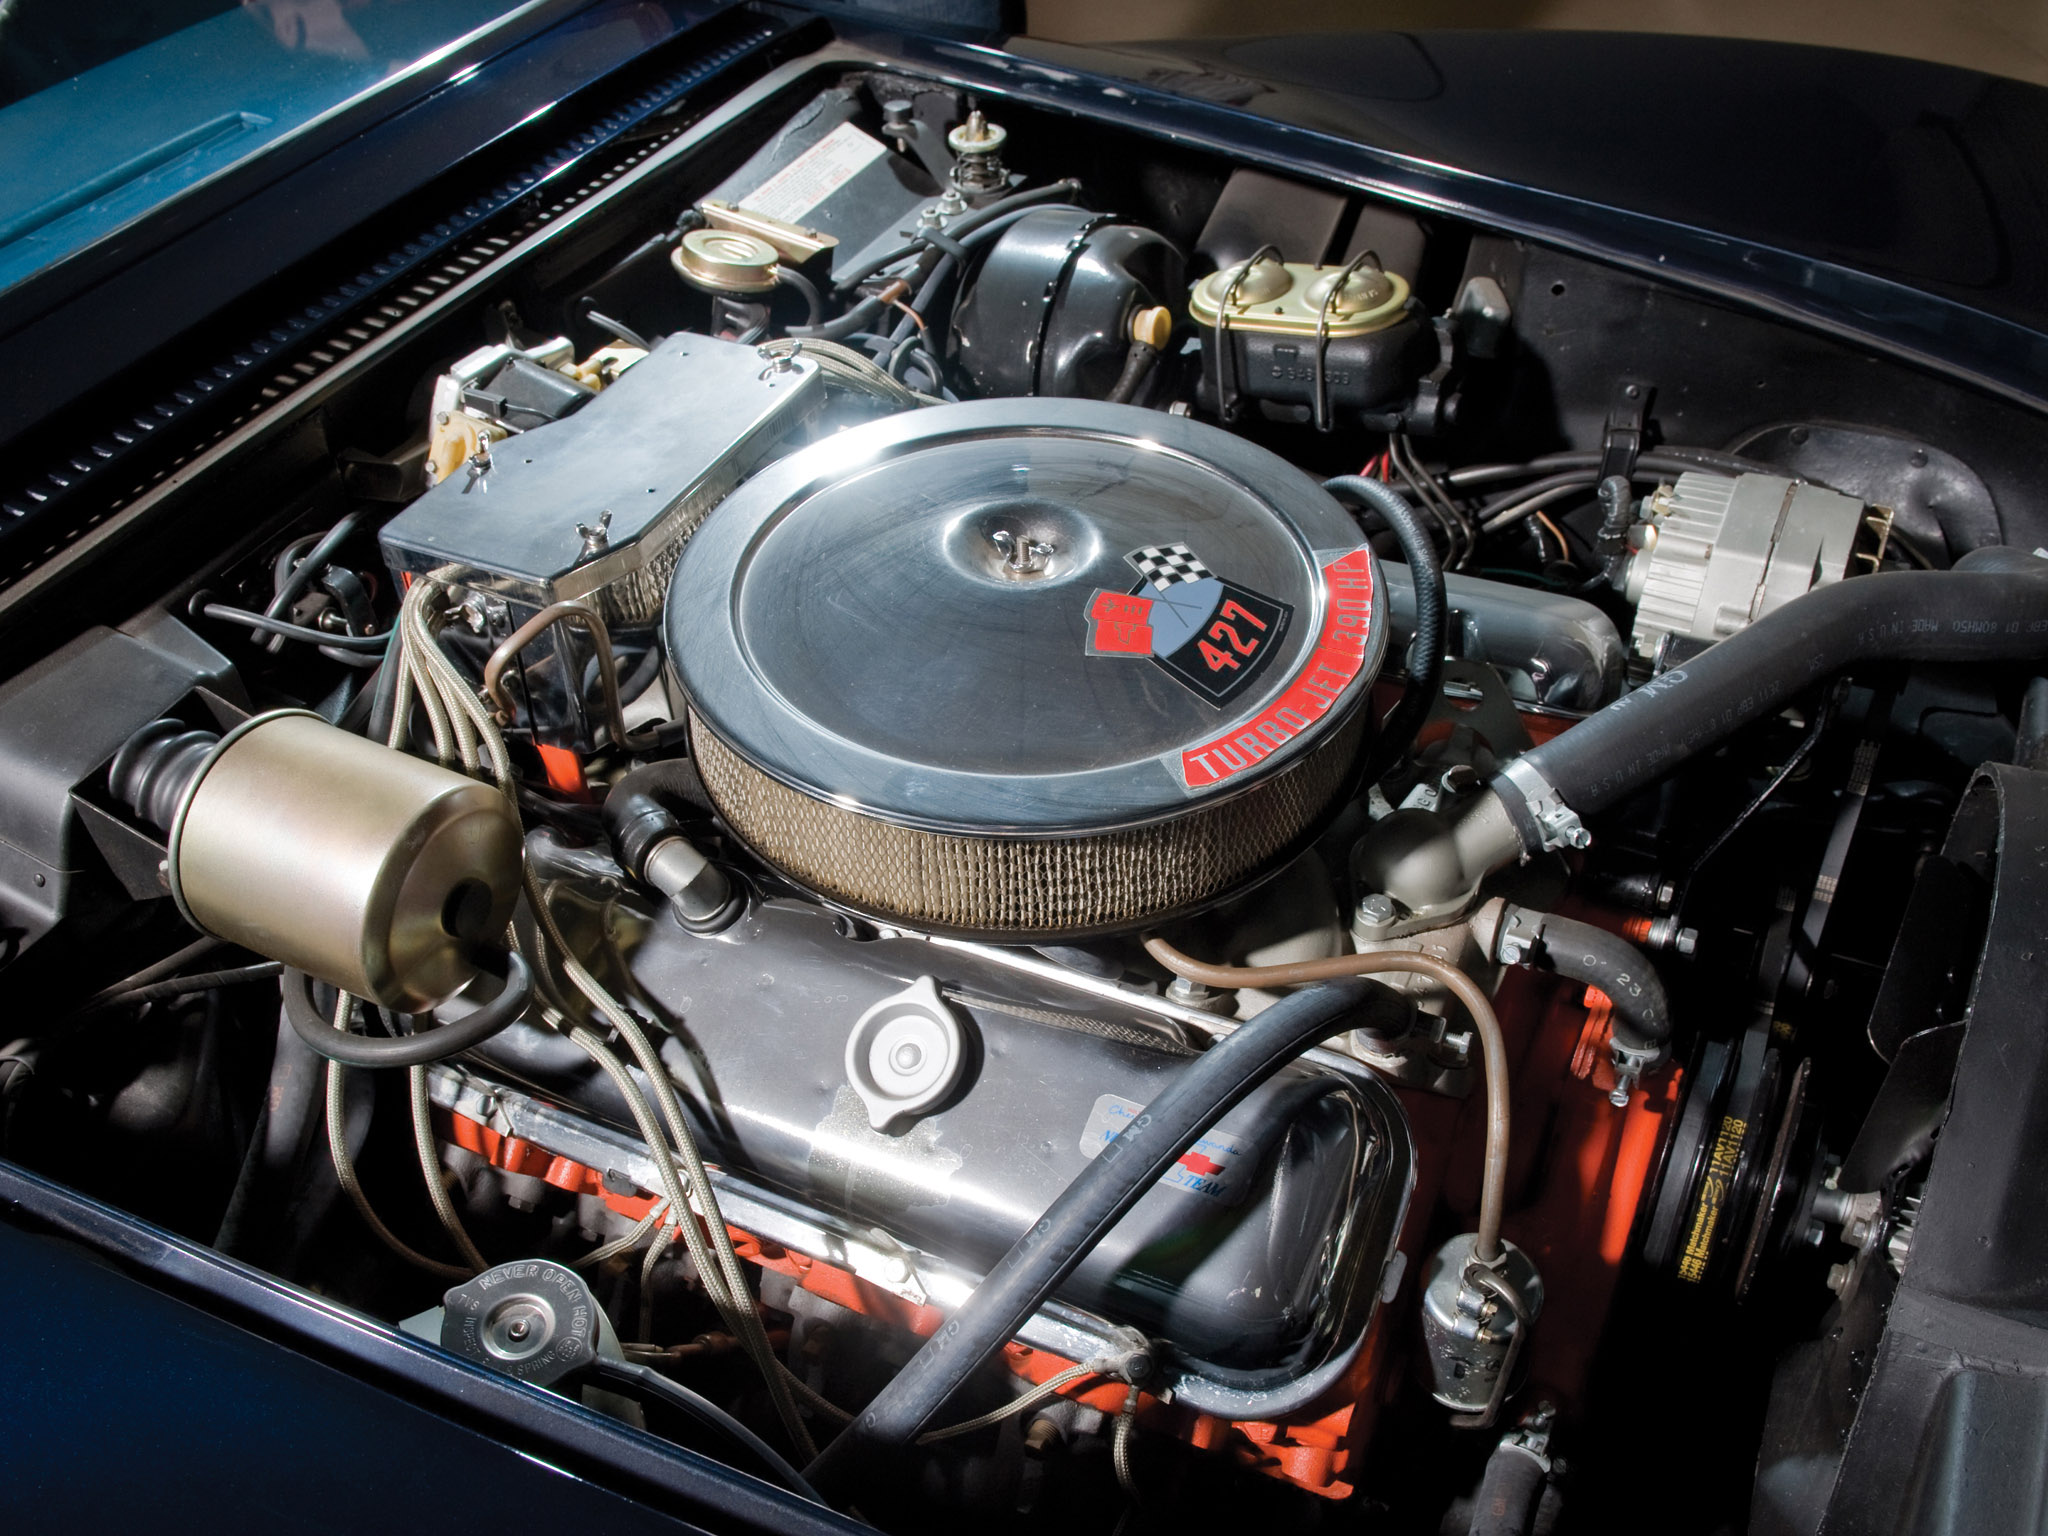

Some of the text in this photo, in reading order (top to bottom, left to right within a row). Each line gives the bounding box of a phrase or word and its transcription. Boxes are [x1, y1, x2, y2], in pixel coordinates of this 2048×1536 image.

[1197, 599, 1268, 672] 427
[1911, 618, 1940, 632] MADE
[1189, 662, 1351, 779] TURBO-JET
[1183, 1174, 1227, 1197] TEAM
[1685, 1202, 1709, 1255] Matchmaker
[1695, 1206, 1720, 1259] Matchmaker
[478, 1264, 588, 1339] NEVER OPEN HOT
[517, 1349, 557, 1376] SPRING
